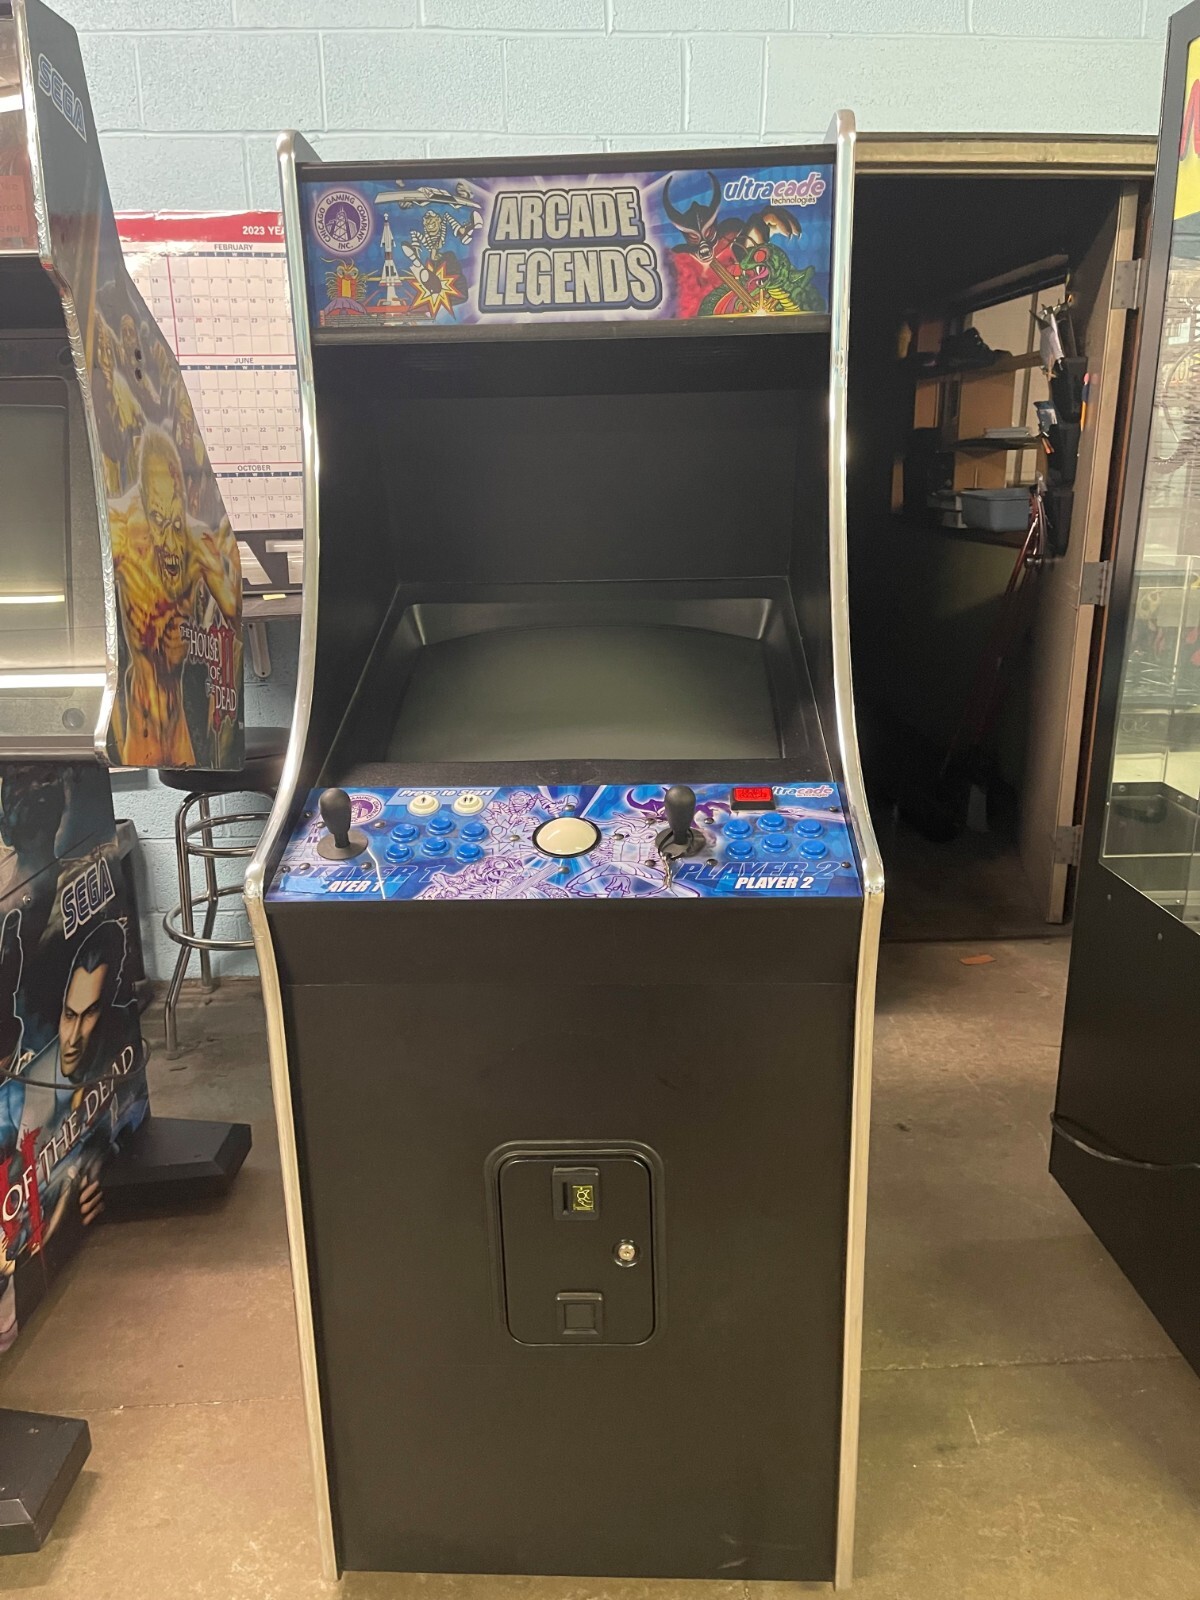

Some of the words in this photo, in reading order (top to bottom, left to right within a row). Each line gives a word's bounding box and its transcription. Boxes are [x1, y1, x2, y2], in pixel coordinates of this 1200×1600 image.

[38, 53, 87, 143] SEGA
[724, 172, 826, 200] ultracade
[771, 194, 816, 206] technologies
[317, 207, 331, 243] CHICAGO
[326, 194, 355, 205] GAMING
[357, 205, 368, 243] COMPANY
[491, 189, 643, 244] ARCADE
[242, 225, 265, 236] 2023
[267, 226, 285, 236] YEA
[214, 243, 254, 251] FEBRUARY
[484, 246, 659, 308] LEGENDS
[190, 630, 219, 662] HOUSE
[215, 685, 237, 712] DEAD
[441, 789, 456, 797] to
[772, 784, 834, 798] ltracade
[672, 861, 809, 880] PLAYER
[734, 876, 799, 889] PLAYER
[801, 876, 815, 889] 2
[61, 856, 115, 940] SEGA
[327, 879, 372, 893] AYER
[2, 1164, 33, 1222] OF
[38, 1110, 80, 1184] THE
